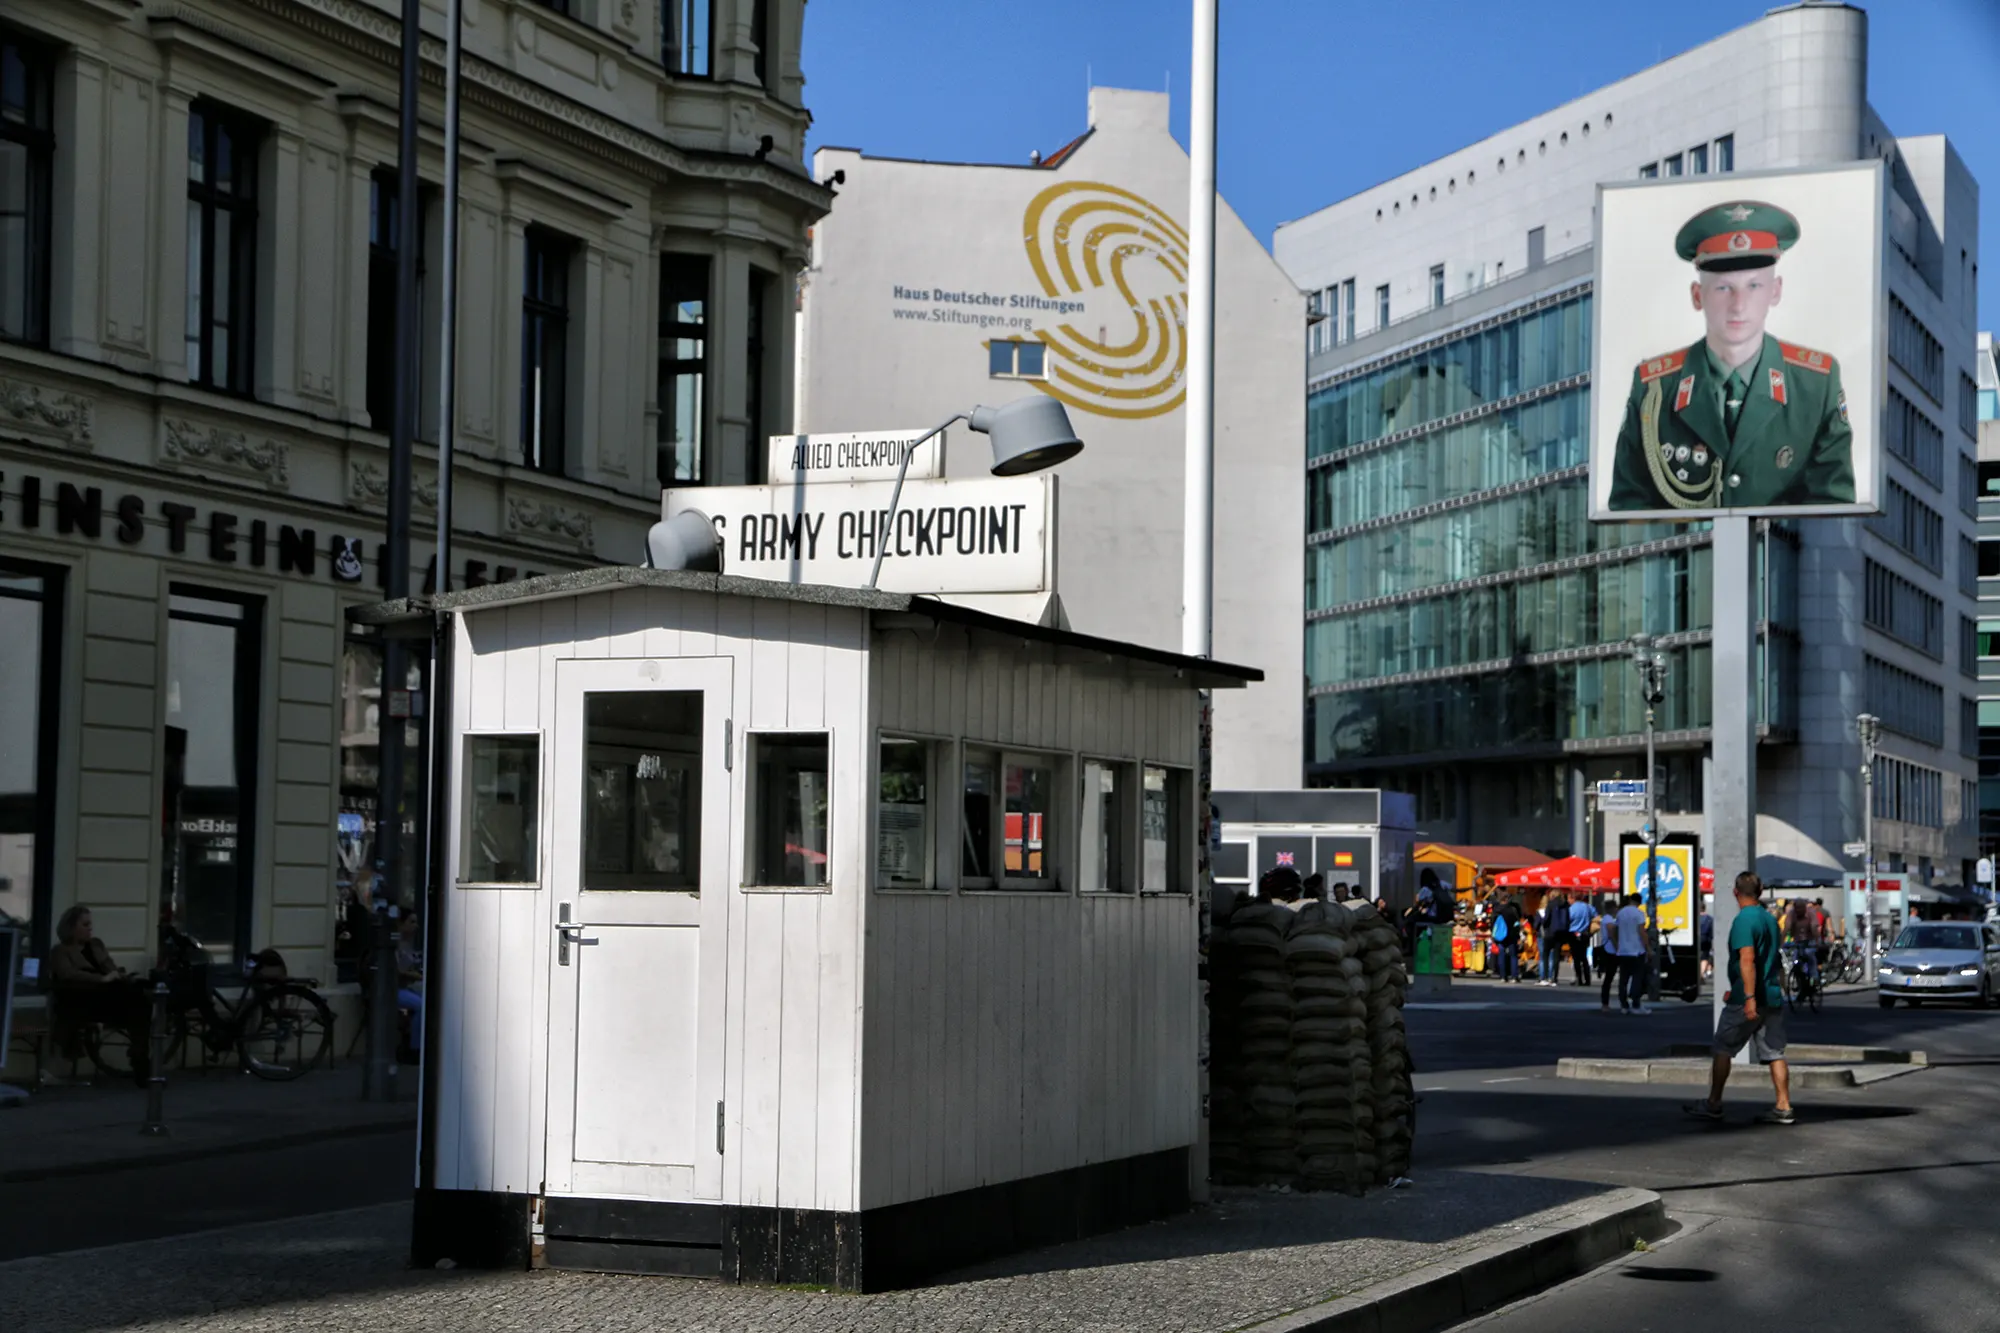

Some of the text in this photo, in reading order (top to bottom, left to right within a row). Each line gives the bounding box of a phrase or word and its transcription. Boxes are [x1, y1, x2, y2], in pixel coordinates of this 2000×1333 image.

[894, 285, 1085, 314] Haus Deutscher Stiftungen
[893, 308, 1032, 331] www.Stiftungen.org
[791, 442, 832, 470] ALLIED
[0, 471, 315, 574] INSTEIN
[740, 512, 825, 561] ARMY
[837, 504, 1026, 559] CHECKPOINT
